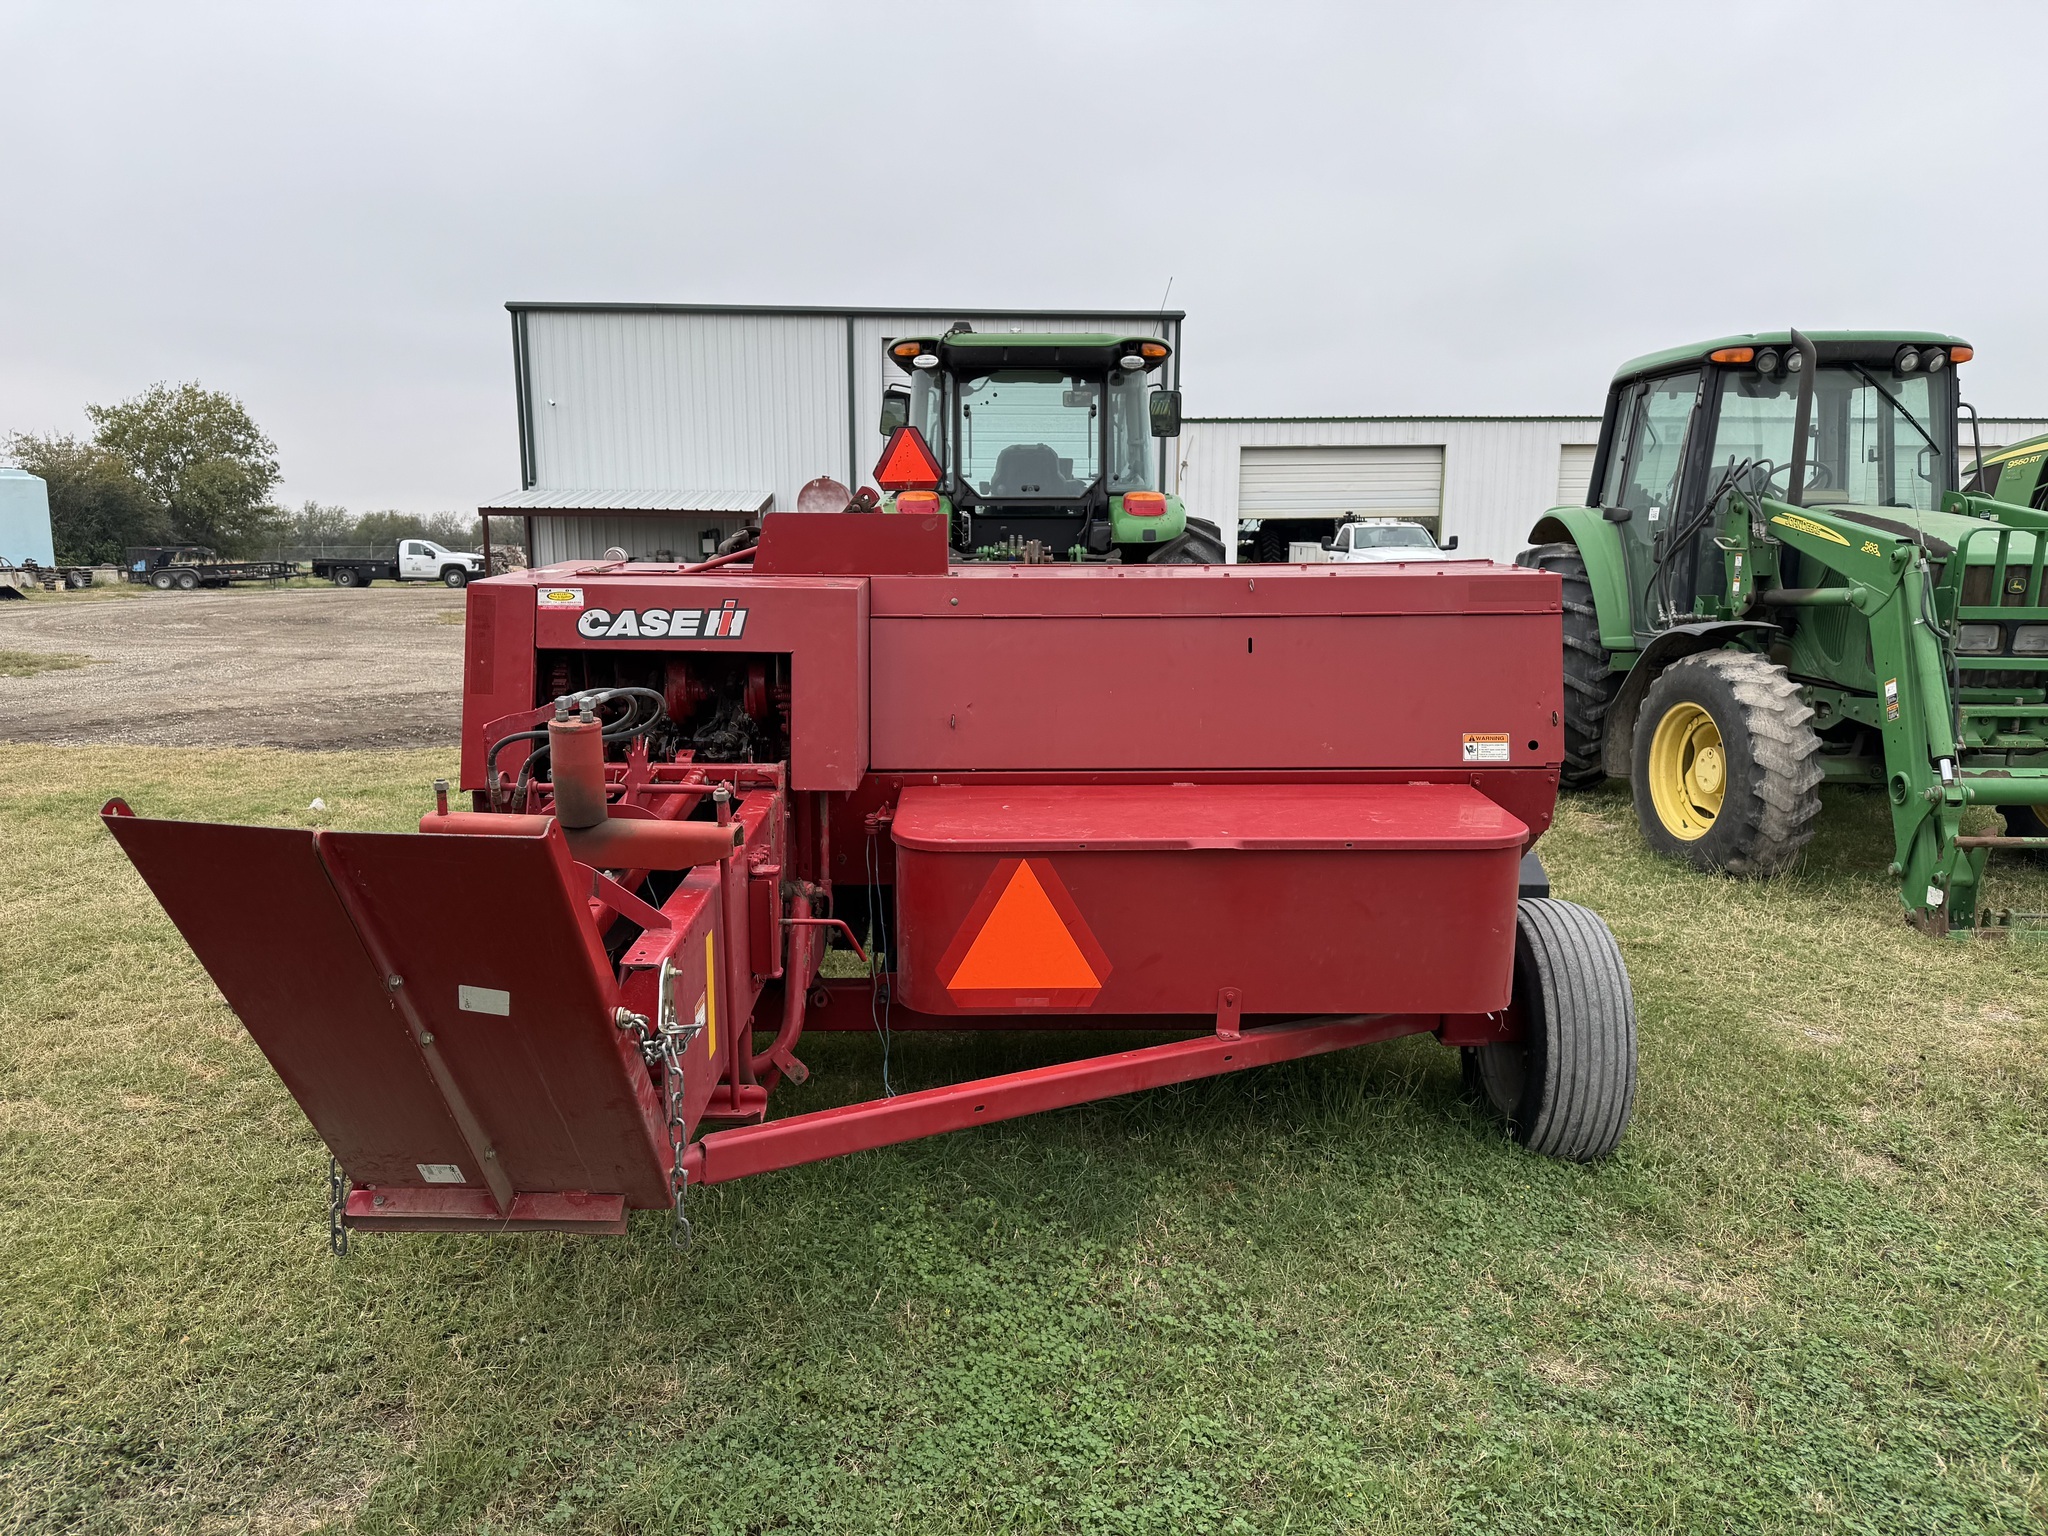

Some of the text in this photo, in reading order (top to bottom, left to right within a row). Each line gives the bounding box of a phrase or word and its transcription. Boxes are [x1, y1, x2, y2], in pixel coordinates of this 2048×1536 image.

[2007, 454, 2042, 469] 9560 RT
[1785, 515, 1822, 536] JOHN DEERE
[577, 608, 702, 638] CASE
